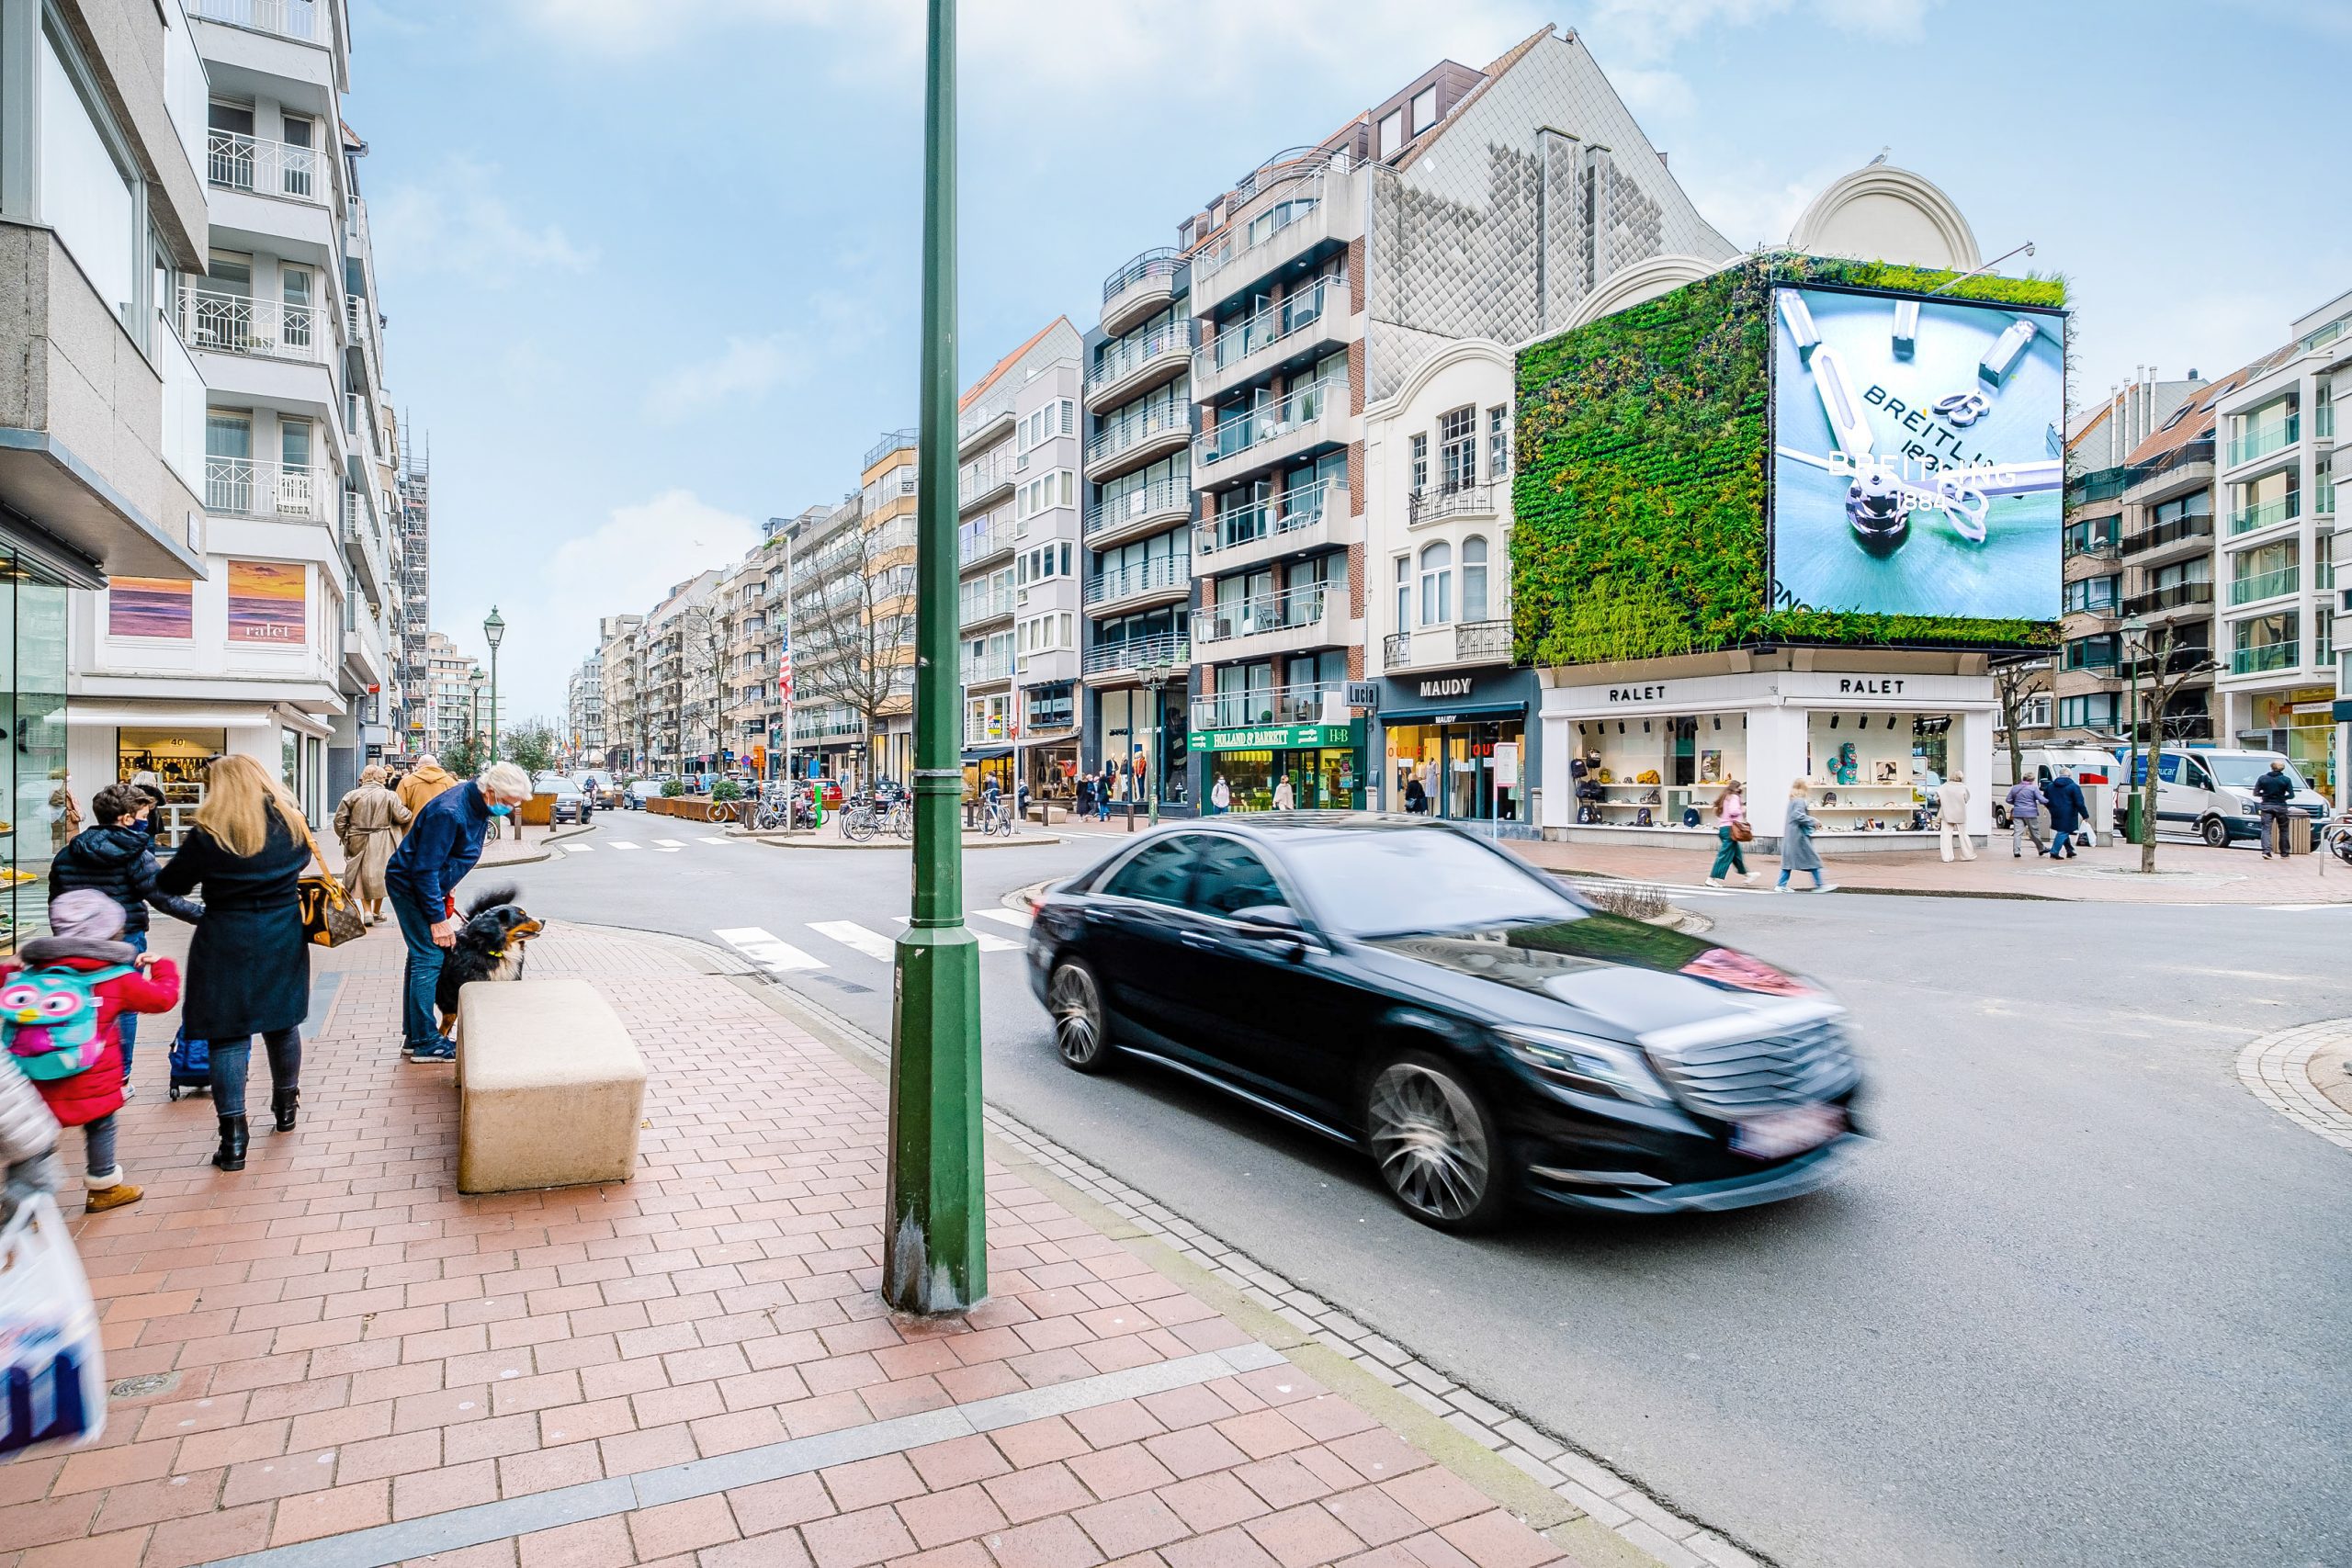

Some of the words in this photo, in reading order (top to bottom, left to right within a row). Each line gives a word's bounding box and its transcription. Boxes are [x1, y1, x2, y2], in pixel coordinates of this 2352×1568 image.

[1863, 384, 1996, 469] BREITLI
[1896, 491, 1947, 512] 1884
[246, 622, 288, 637] ralet
[1350, 685, 1374, 703] Lucia
[1419, 678, 1472, 696] MAUDY
[1610, 685, 1665, 701] RALET
[1840, 679, 1905, 694] RALET
[1435, 715, 1456, 723] MAUDY
[1214, 732, 1246, 747] HOLLAND
[1247, 731, 1253, 747] &
[1254, 729, 1288, 745] BARRETT
[1387, 745, 1428, 758] OUTLET
